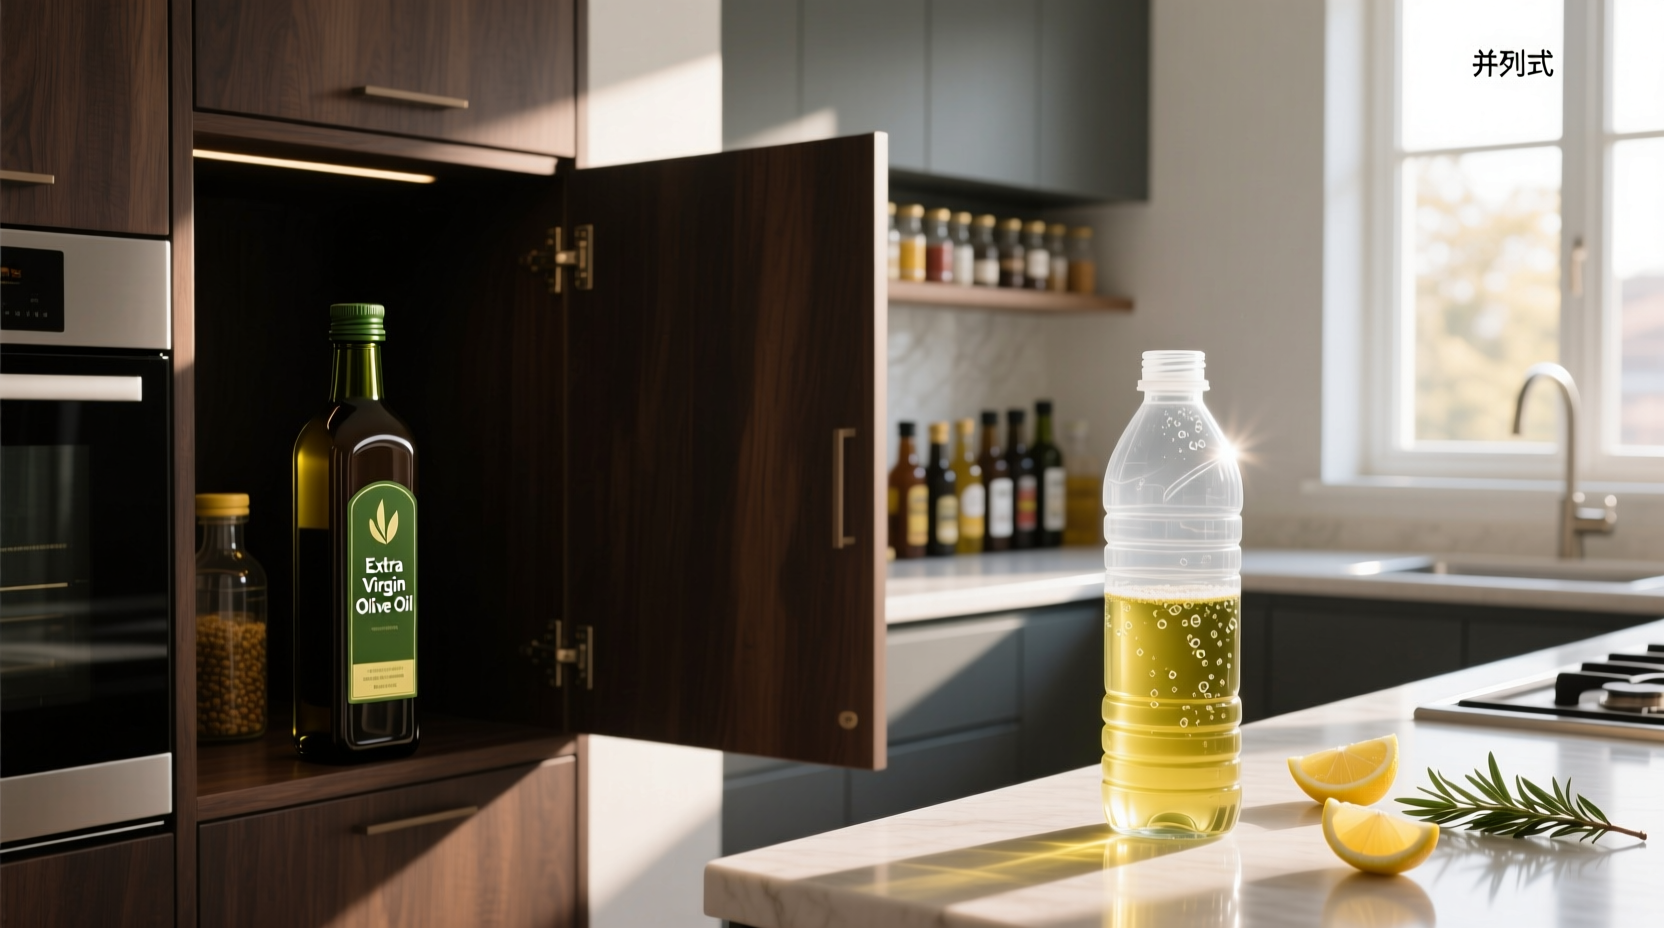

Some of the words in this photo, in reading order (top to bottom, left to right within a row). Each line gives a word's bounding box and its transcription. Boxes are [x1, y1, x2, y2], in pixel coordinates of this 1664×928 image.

[365, 557, 403, 574] Extra
[362, 576, 406, 597] Virgin
[355, 597, 392, 615] Olive
[394, 595, 413, 612] Oil
